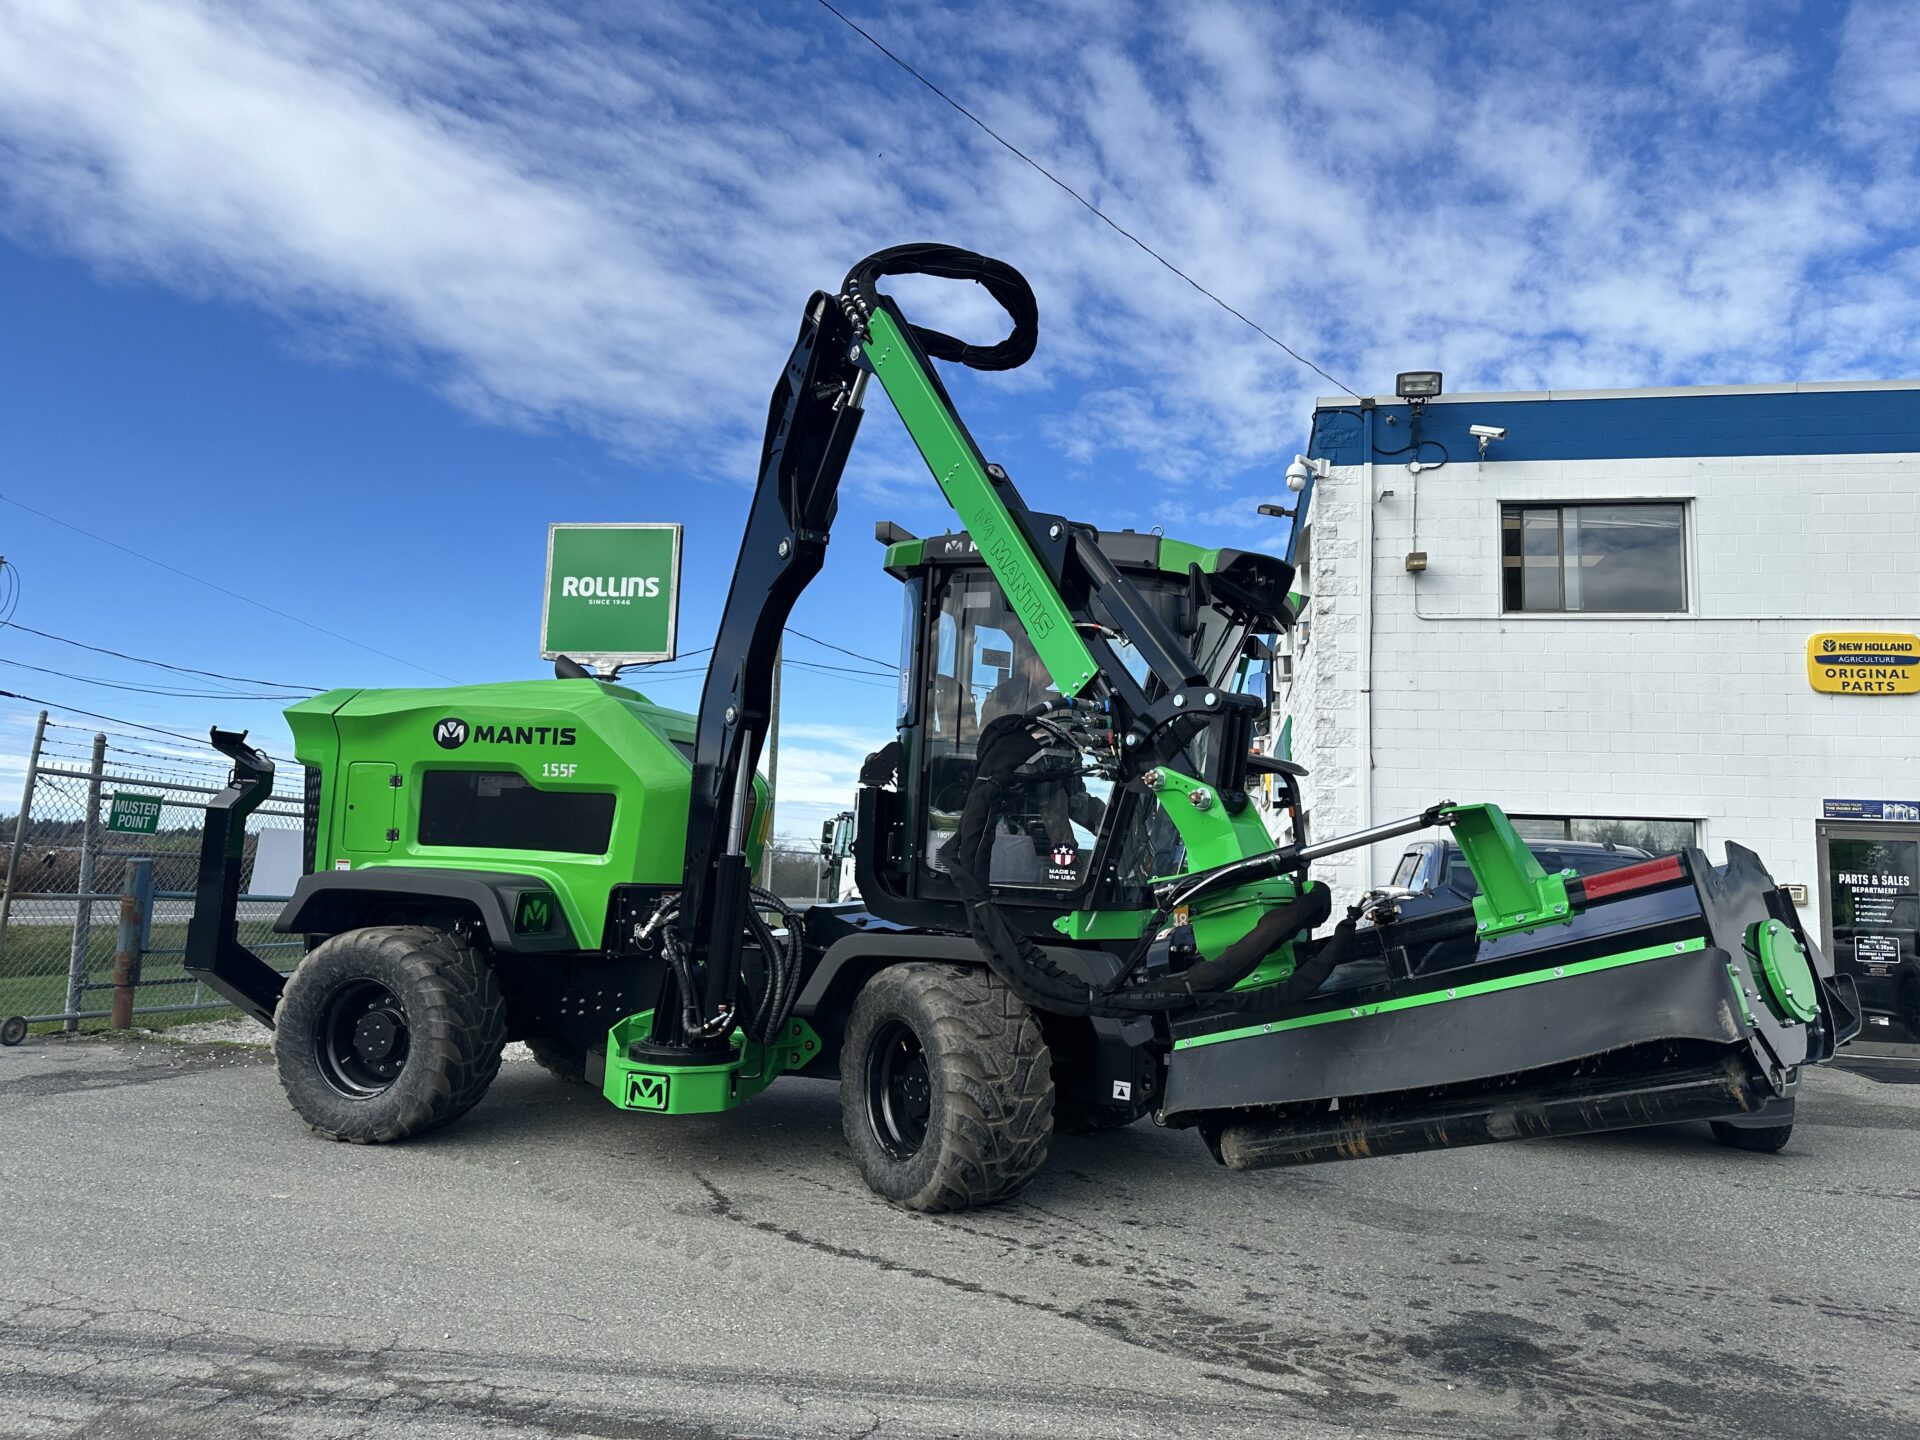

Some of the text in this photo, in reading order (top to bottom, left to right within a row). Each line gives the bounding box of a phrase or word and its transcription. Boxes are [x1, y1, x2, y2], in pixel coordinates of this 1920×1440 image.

[562, 576, 660, 598] ROLLINS
[989, 537, 1055, 640] MANTIS
[1838, 642, 1913, 652] NEW HOLLAND
[1825, 668, 1910, 679] ORIGINAL
[1841, 681, 1896, 692] PARTS
[473, 725, 577, 746] MANTIS
[541, 762, 578, 778] 155F
[114, 799, 159, 816] MUSTER
[117, 814, 151, 829] POINT
[1838, 873, 1910, 887] PARTS & SALES
[1851, 886, 1898, 895] DEPARTMENT
